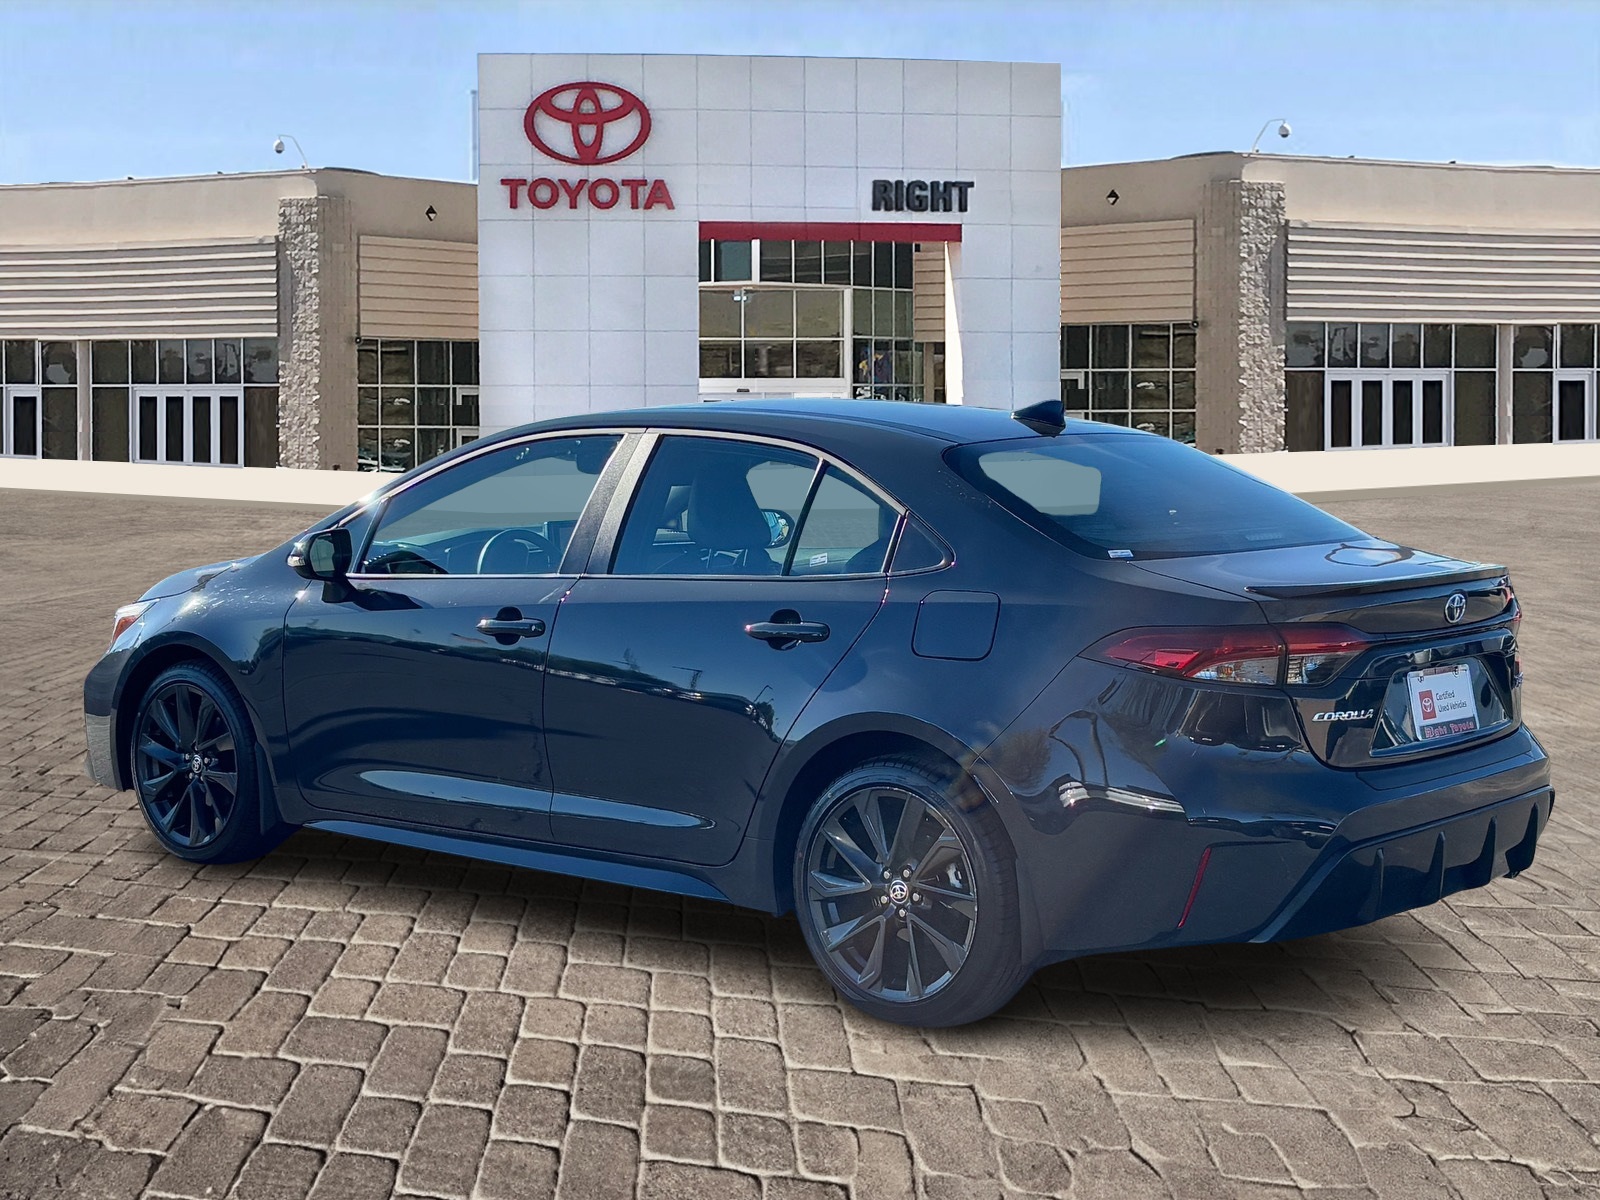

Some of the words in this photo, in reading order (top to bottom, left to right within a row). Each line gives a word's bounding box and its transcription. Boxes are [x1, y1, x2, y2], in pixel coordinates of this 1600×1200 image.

[501, 179, 674, 209] TOYOTA
[872, 180, 975, 212] RIGHT
[1436, 690, 1455, 701] Certified
[1438, 704, 1449, 713] Used
[1450, 701, 1467, 710] Vehicles
[1312, 709, 1374, 722] COROLLA
[1425, 726, 1448, 738] Right
[1450, 721, 1475, 734] Toyota
